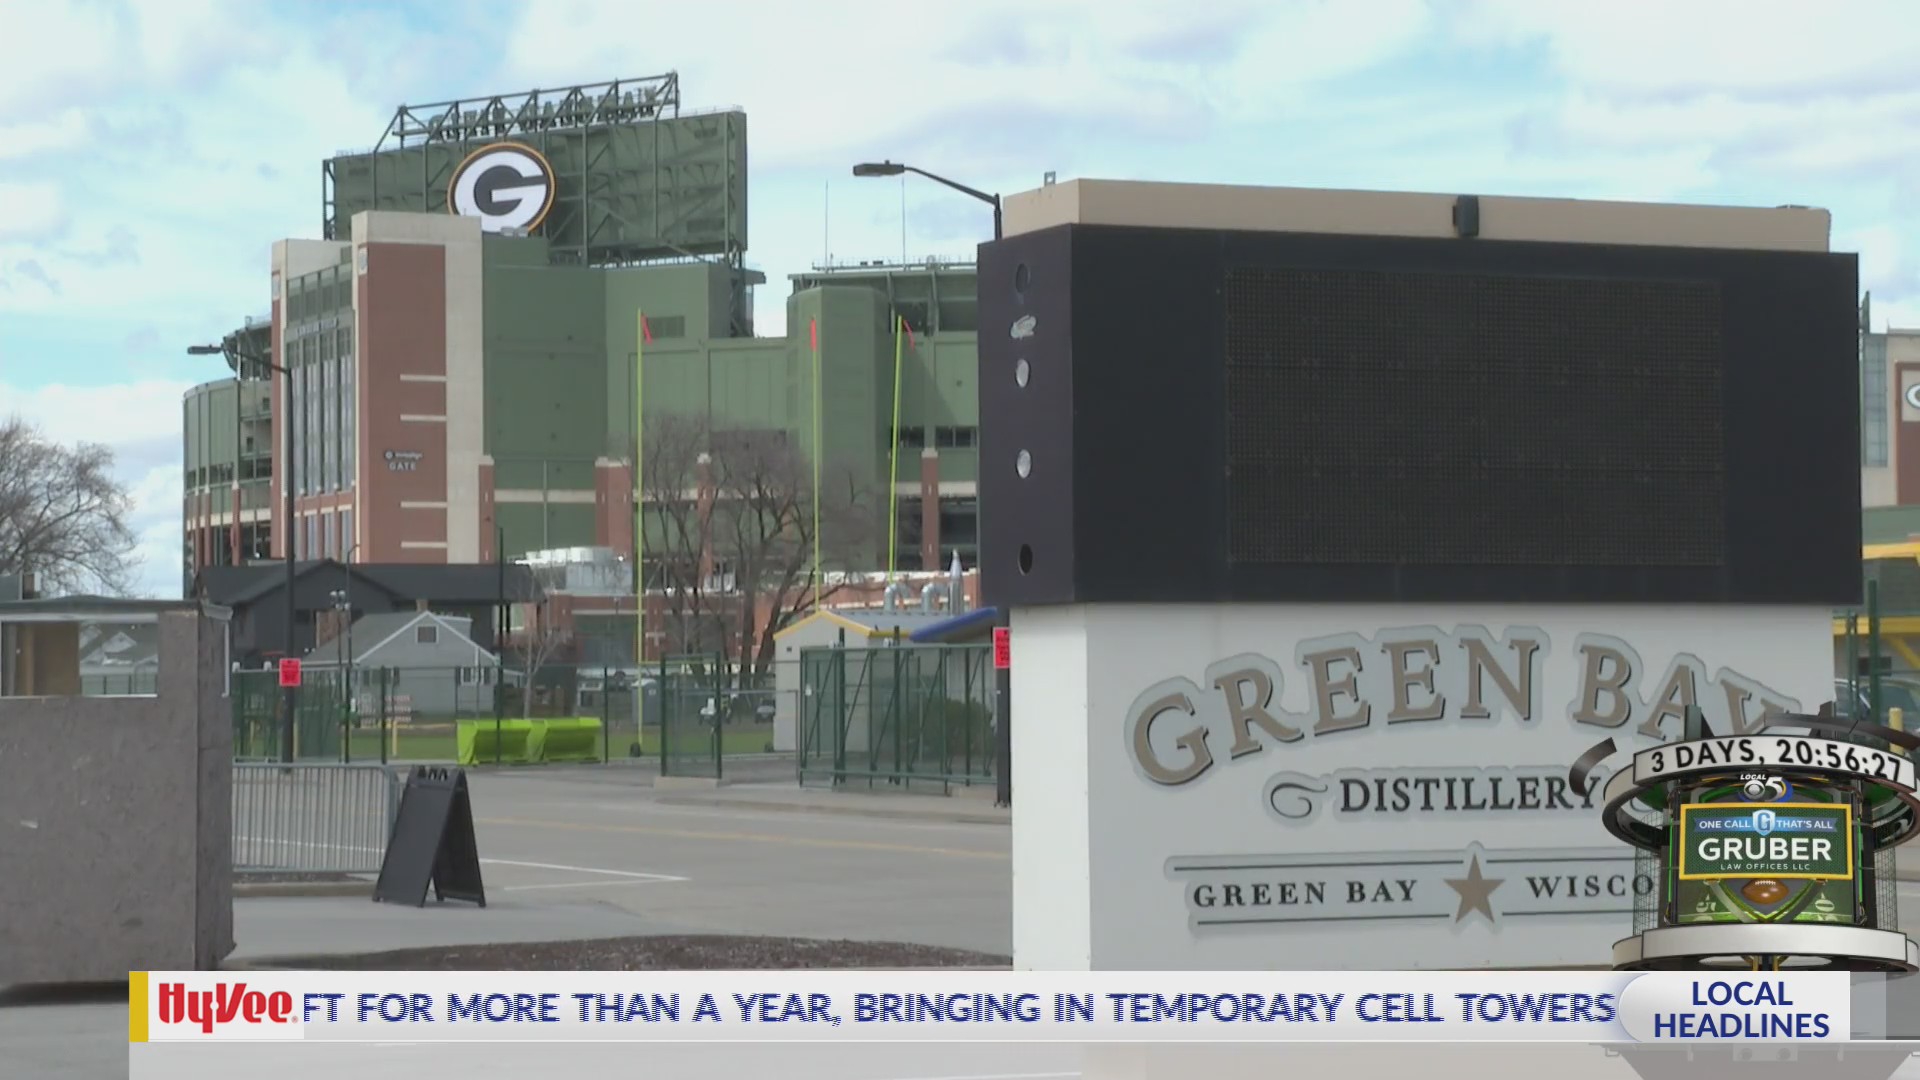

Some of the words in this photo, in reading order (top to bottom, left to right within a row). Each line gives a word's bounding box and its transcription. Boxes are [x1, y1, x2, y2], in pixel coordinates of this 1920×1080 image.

[455, 151, 547, 232] G
[388, 462, 417, 471] GATE
[1131, 638, 1541, 785] GREEN
[1340, 776, 1601, 813] DISTILLERY
[1193, 881, 1326, 908] GREEN
[1346, 879, 1418, 904] BAY
